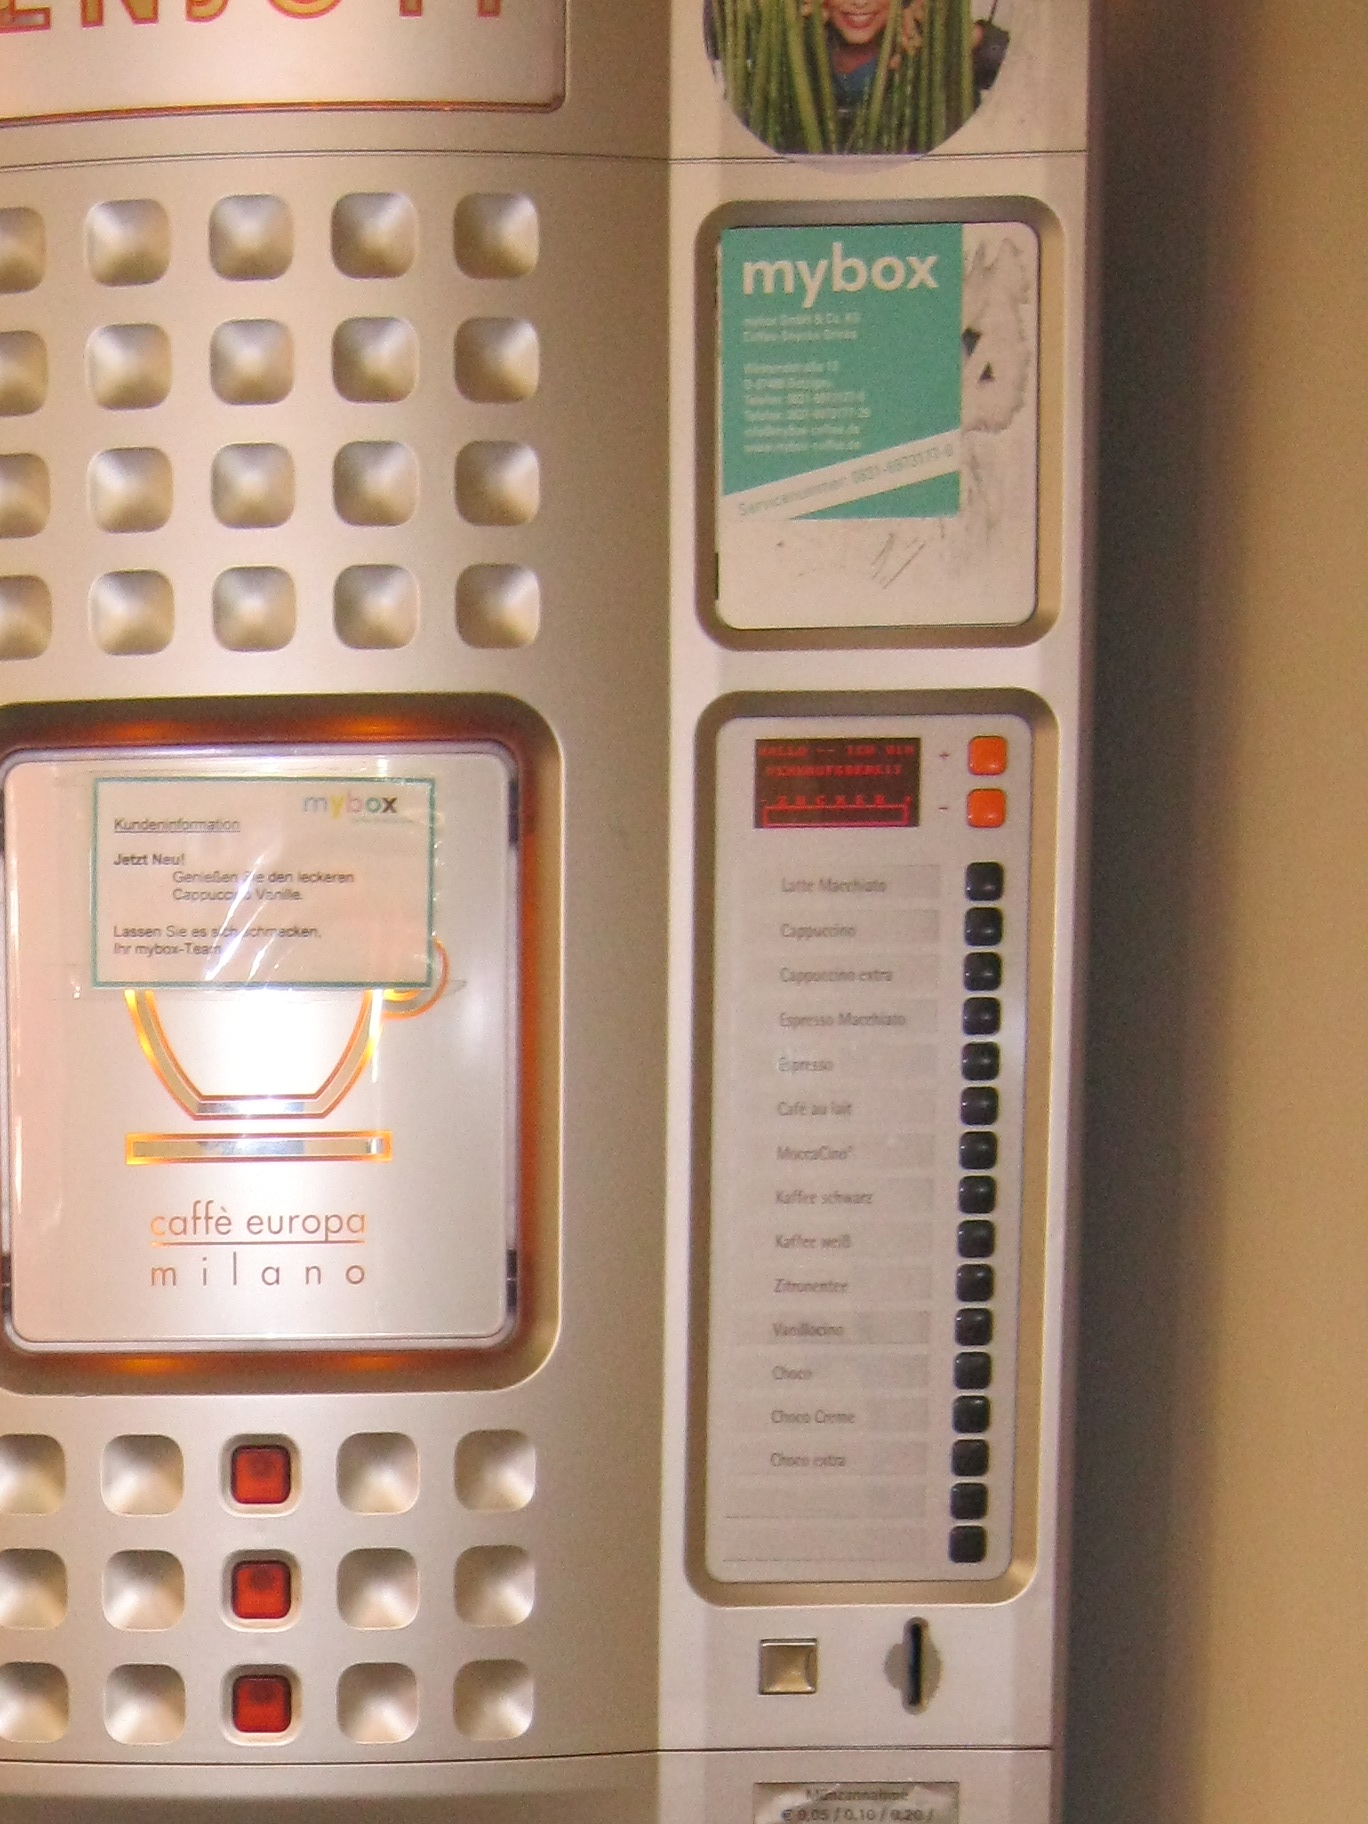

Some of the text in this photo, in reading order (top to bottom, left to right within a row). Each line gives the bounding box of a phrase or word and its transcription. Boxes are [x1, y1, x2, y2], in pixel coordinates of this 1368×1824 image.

[743, 241, 938, 309] mybox
[302, 790, 398, 818] mybox
[113, 817, 241, 833] Kundeninformation
[113, 853, 185, 866] Jetzt Neu!
[172, 870, 238, 884] Genießen
[268, 870, 293, 884] den
[299, 870, 354, 884] leckeren
[781, 877, 887, 893] Latte Macchiato
[113, 924, 162, 938] Lassen
[166, 924, 187, 938] Sie
[191, 927, 207, 938] es
[780, 923, 857, 942] Cappuccino
[113, 942, 222, 958] Ihr mybox-Team
[780, 967, 893, 985] Cappuccino extra
[779, 1011, 834, 1030] Espresso
[778, 1057, 834, 1075] Espresso
[775, 1189, 873, 1205] Kaffee schwarz
[150, 1200, 367, 1242] caffè europa
[775, 1233, 851, 1249] Kaffee weiß
[771, 1365, 813, 1380] Choco
[770, 1409, 811, 1424] Choco
[770, 1452, 810, 1467] Choco
